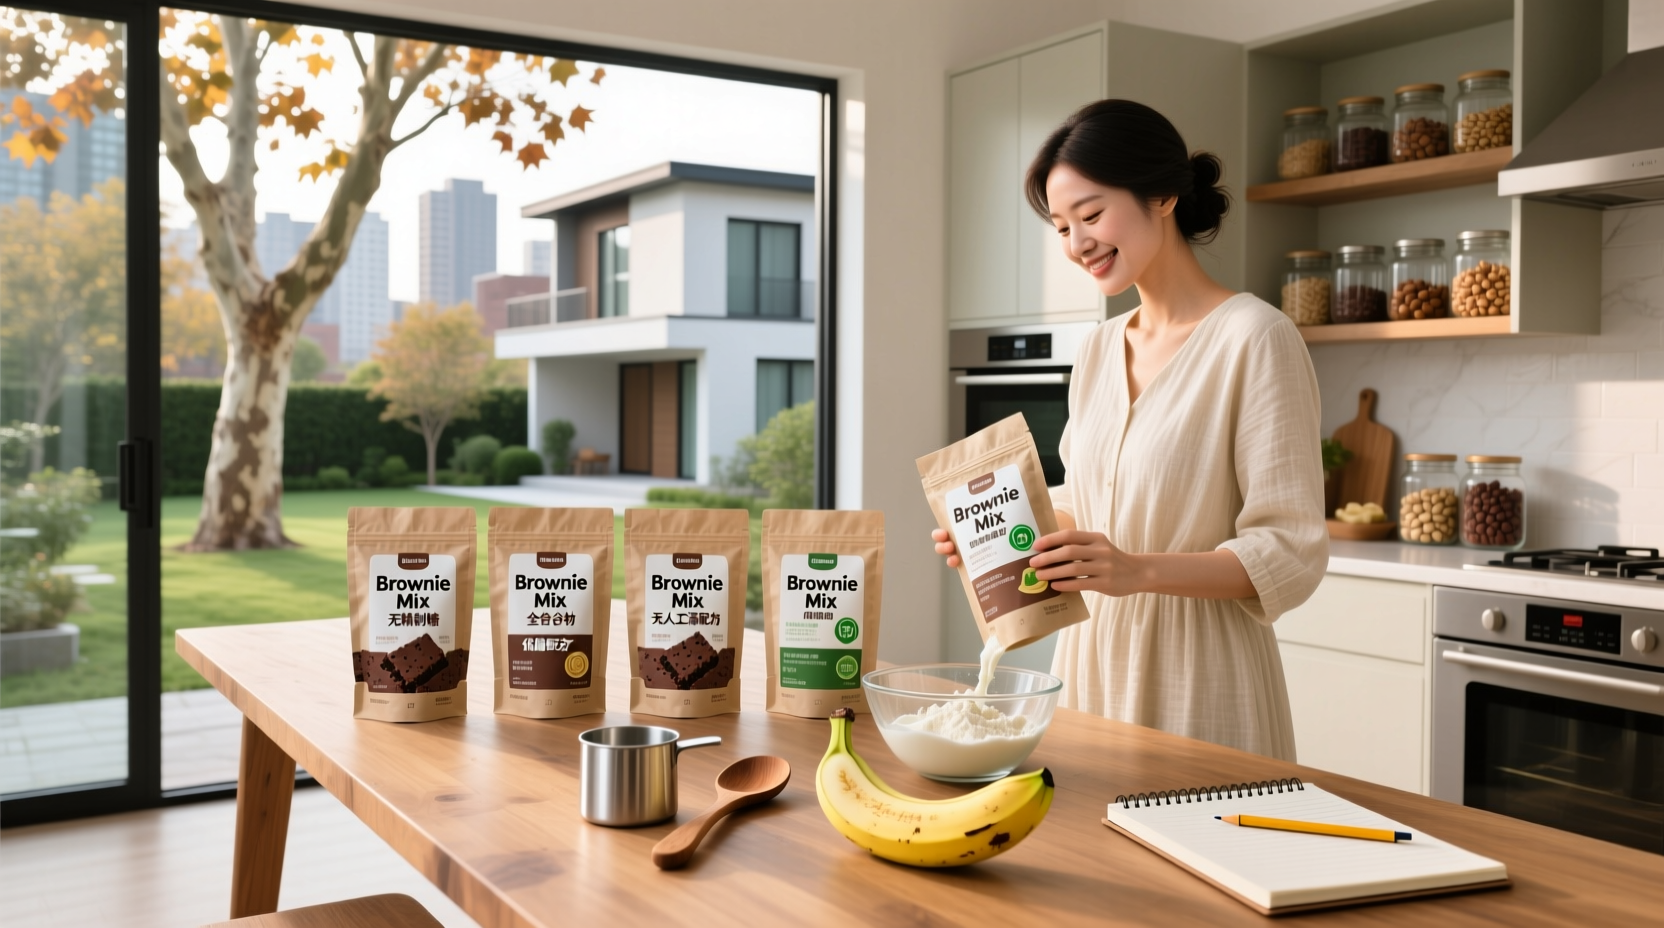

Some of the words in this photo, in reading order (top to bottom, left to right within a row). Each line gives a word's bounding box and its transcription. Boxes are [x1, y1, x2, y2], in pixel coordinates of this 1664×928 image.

[953, 487, 1019, 524] Brownie
[974, 511, 1006, 534] Mix
[377, 575, 450, 591] Brownie
[516, 574, 587, 590] Brownie
[652, 575, 723, 591] Brownie
[788, 575, 858, 591] Brownie
[397, 594, 429, 609] Mix
[535, 593, 566, 608] Mix
[672, 593, 703, 608] Mix
[806, 593, 837, 608] Mix
